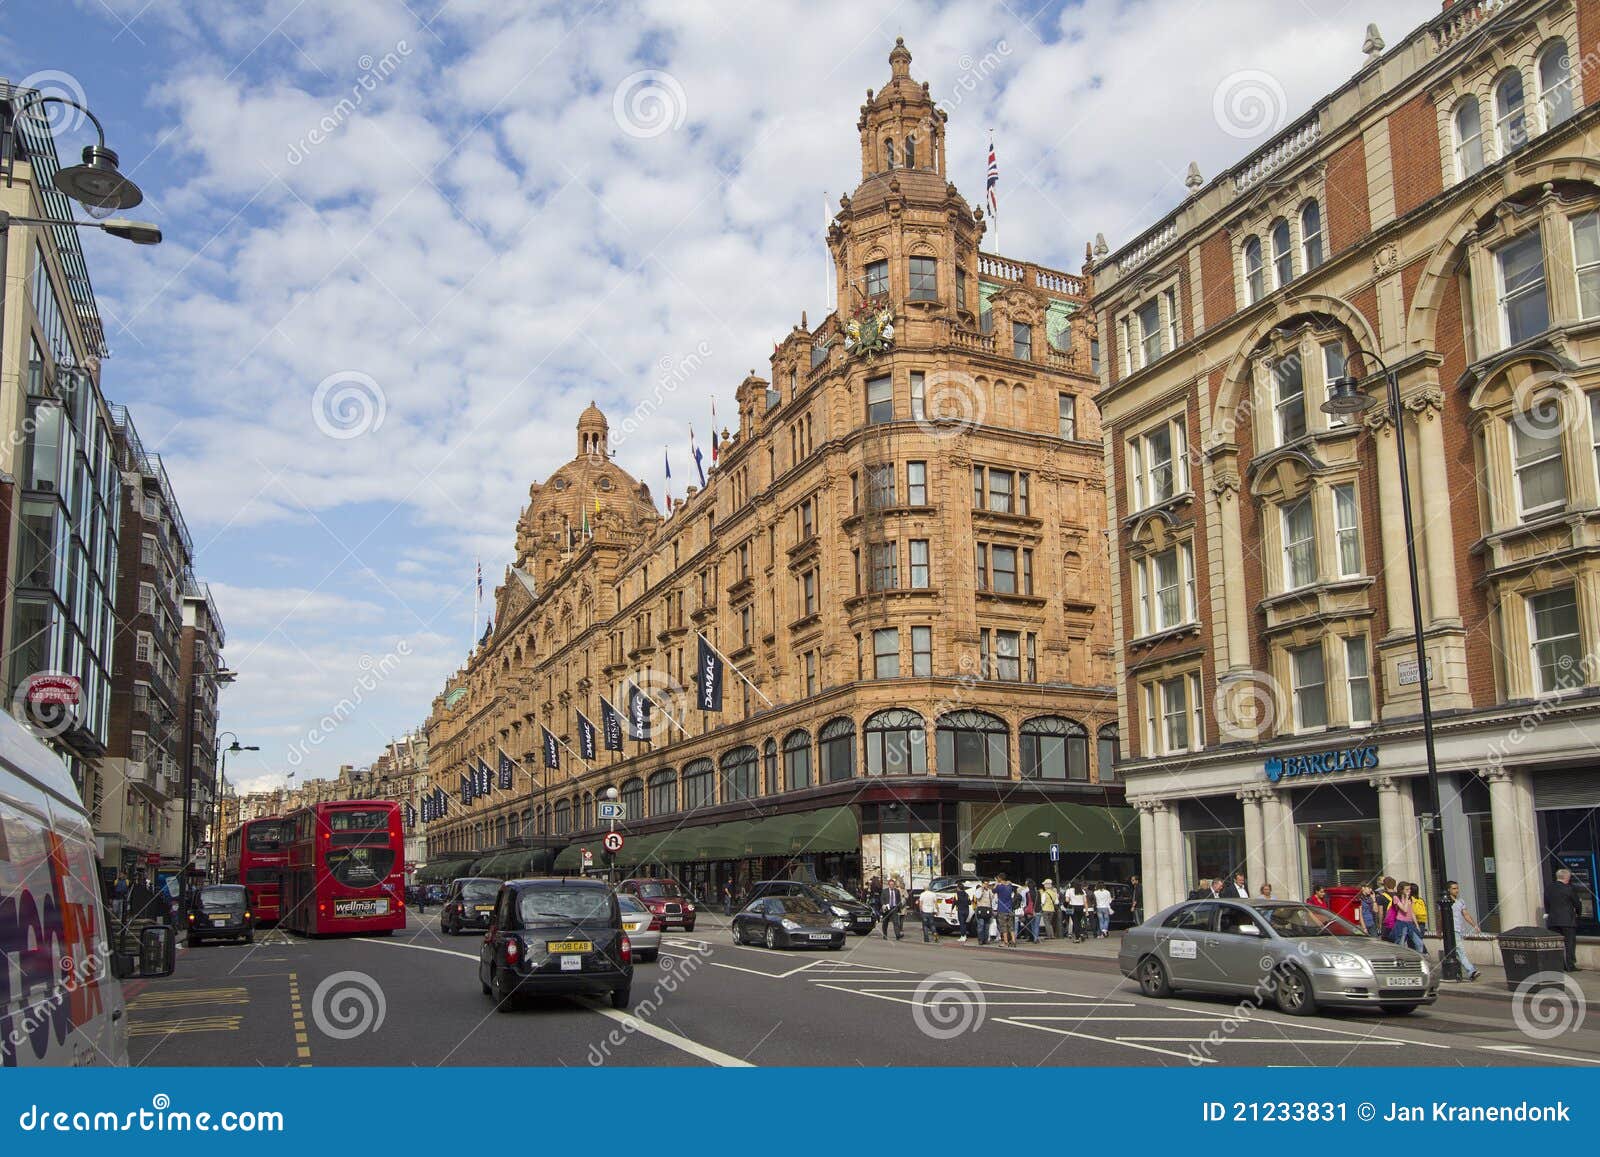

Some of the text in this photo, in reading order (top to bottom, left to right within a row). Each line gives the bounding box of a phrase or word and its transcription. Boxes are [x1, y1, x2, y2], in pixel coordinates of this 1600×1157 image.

[704, 655, 715, 709] DAMAC
[636, 696, 645, 740] DAMAC
[1286, 745, 1379, 777] BARCLAYS
[336, 901, 376, 912] wellman
